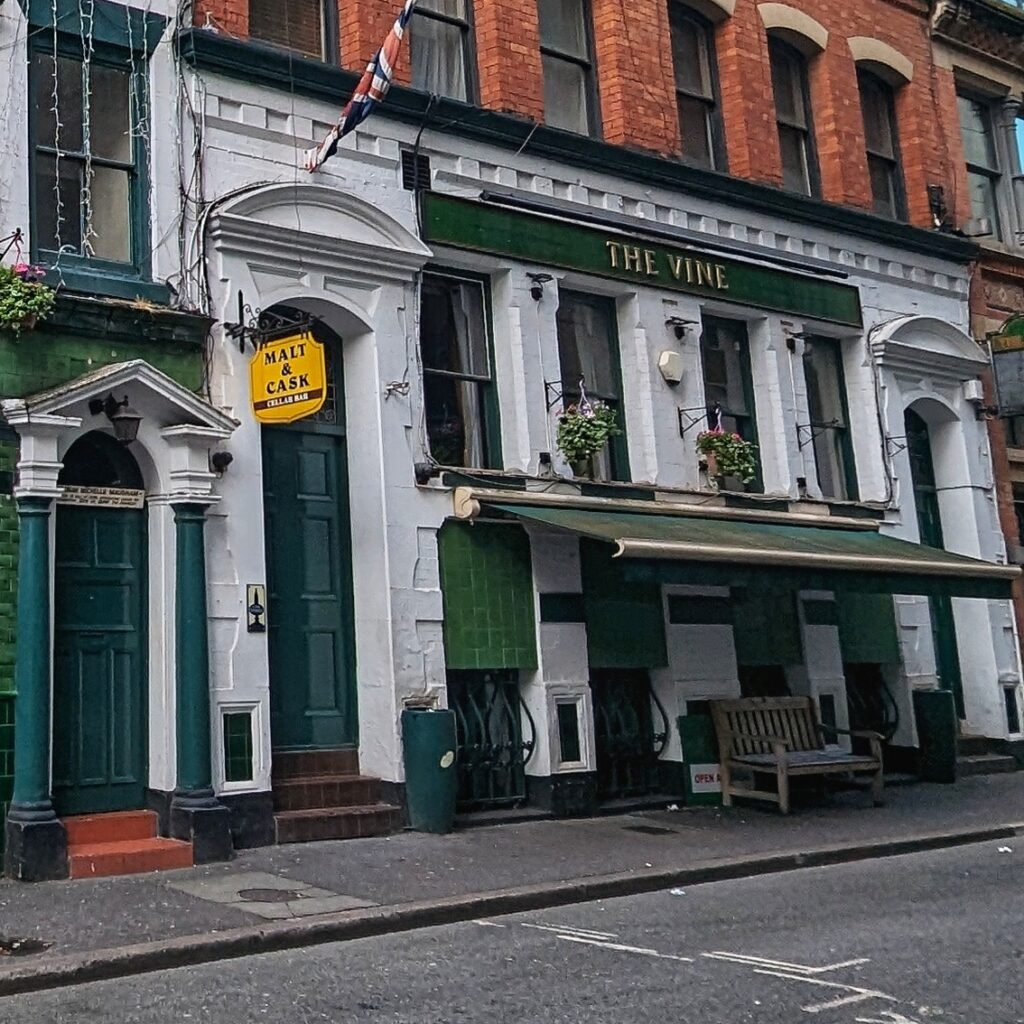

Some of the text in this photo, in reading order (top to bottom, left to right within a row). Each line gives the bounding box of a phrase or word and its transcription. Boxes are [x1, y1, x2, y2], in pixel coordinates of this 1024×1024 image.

[606, 240, 729, 289] THE VINE
[264, 343, 306, 365] MALT
[281, 362, 293, 376] &
[266, 373, 310, 394] CASK
[267, 393, 308, 407] CELLAR BAR
[694, 773, 715, 784] OPEN
